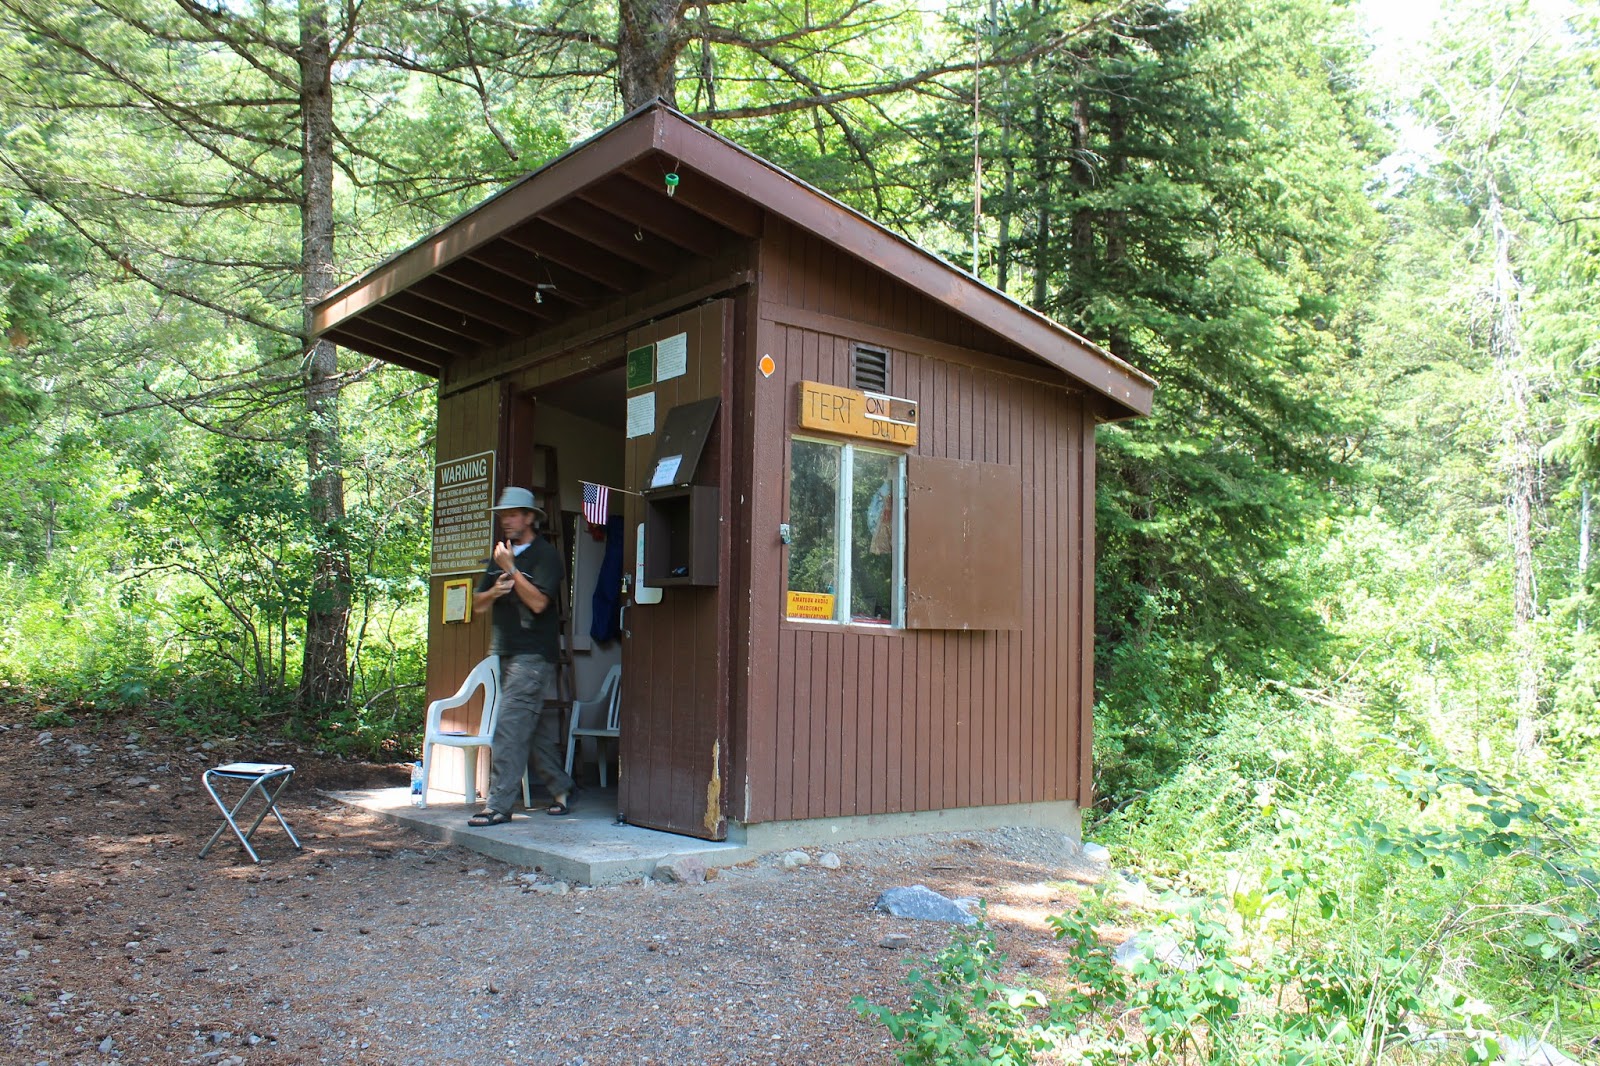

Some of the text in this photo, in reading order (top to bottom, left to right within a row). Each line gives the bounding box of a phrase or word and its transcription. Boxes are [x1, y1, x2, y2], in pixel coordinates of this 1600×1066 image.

[807, 390, 885, 424] TERT ON
[872, 420, 910, 440] DUTY
[441, 458, 486, 484] WARNING
